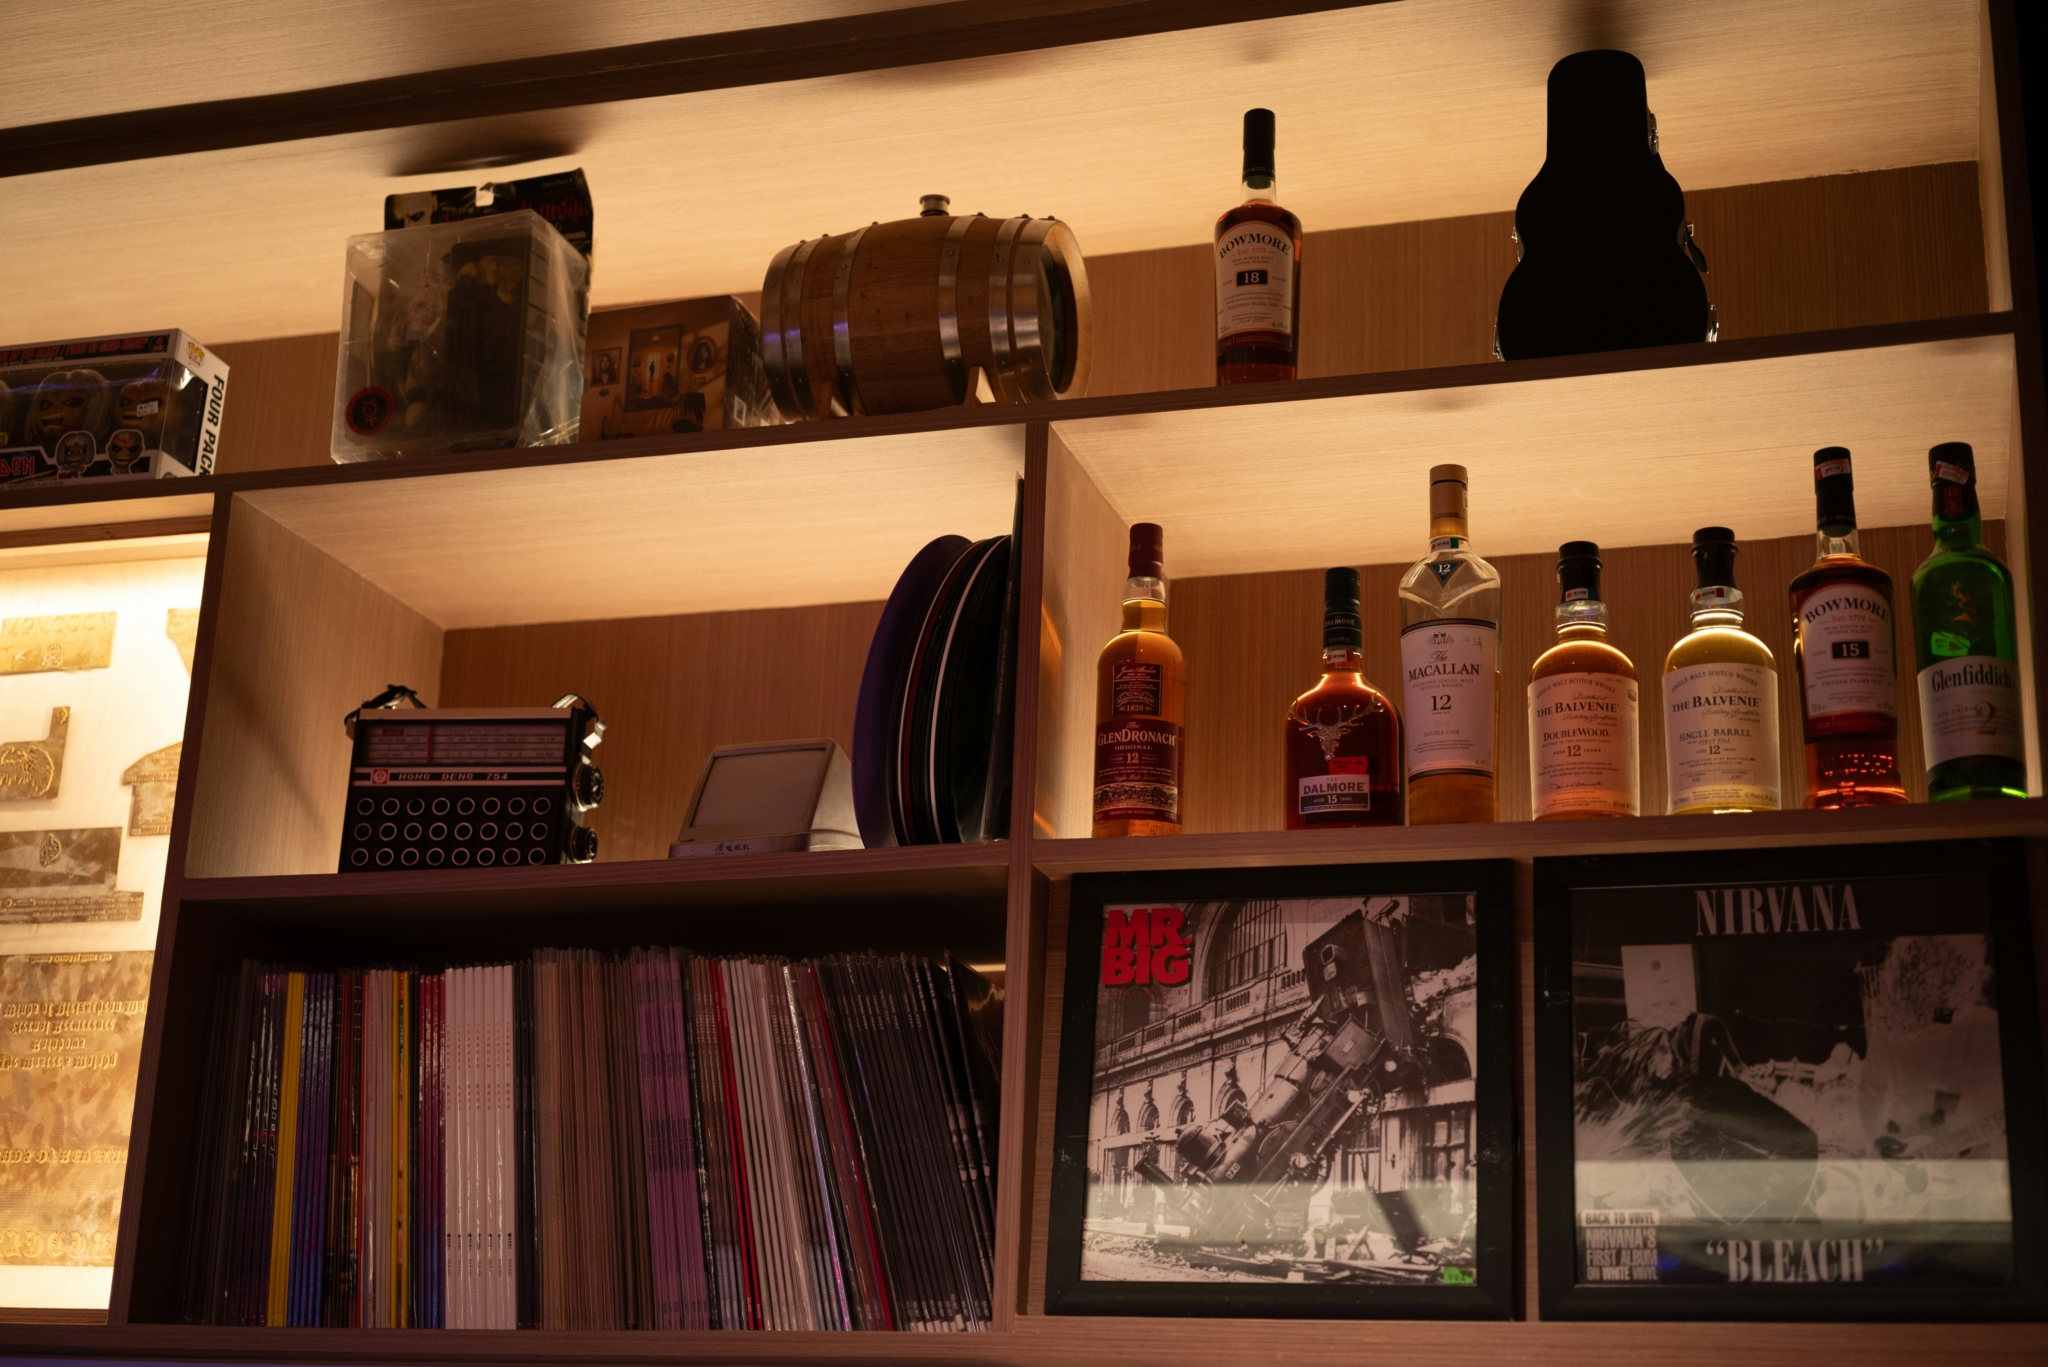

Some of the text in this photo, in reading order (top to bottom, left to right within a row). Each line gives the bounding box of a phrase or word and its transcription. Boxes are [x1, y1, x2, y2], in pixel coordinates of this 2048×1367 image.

[1219, 234, 1290, 259] BOWMORE
[1244, 272, 1259, 284] 18
[207, 374, 225, 427] FOUR
[1437, 563, 1451, 573] 12
[1805, 597, 1889, 624] BOWMORE
[1429, 650, 1448, 664] The
[1842, 643, 1860, 657] 15
[1408, 663, 1480, 682] MACALLAN
[1932, 663, 2014, 693] Glenfiddich
[1536, 685, 1552, 700] SINGLE
[1552, 679, 1568, 689] MALT
[1594, 680, 1616, 694] WHISKY
[1671, 677, 1689, 693] SINGLE
[1689, 671, 1706, 681] MALT
[1736, 674, 1759, 688] WHISKY
[1126, 704, 1144, 712] 1826
[1431, 694, 1452, 712] 12
[1537, 702, 1617, 718] THE BALVENIE
[1672, 696, 1760, 713] THE BALVENIE
[1126, 721, 1140, 730] The
[1423, 730, 1444, 738] DOUBLE
[1679, 728, 1752, 742] SINGLE BARREL
[1567, 745, 1582, 757] 12
[1709, 745, 1721, 755] 12
[1126, 752, 1140, 764] 12
[398, 772, 509, 781] HONG DENG 754
[1303, 782, 1364, 795] DALMORE
[1327, 795, 1338, 804] 15
[1695, 884, 1862, 936] NIRVANA
[1104, 907, 1192, 947] MR.
[1101, 945, 1190, 986] BIG
[1139, 989, 1169, 997] INTO
[1585, 1211, 1656, 1226] BACK TO VINYL
[1585, 1227, 1657, 1249] NIRVANA'S
[1586, 1248, 1658, 1267] FIRST ALBUM
[1587, 1265, 1659, 1281] ON WHITE VINYL
